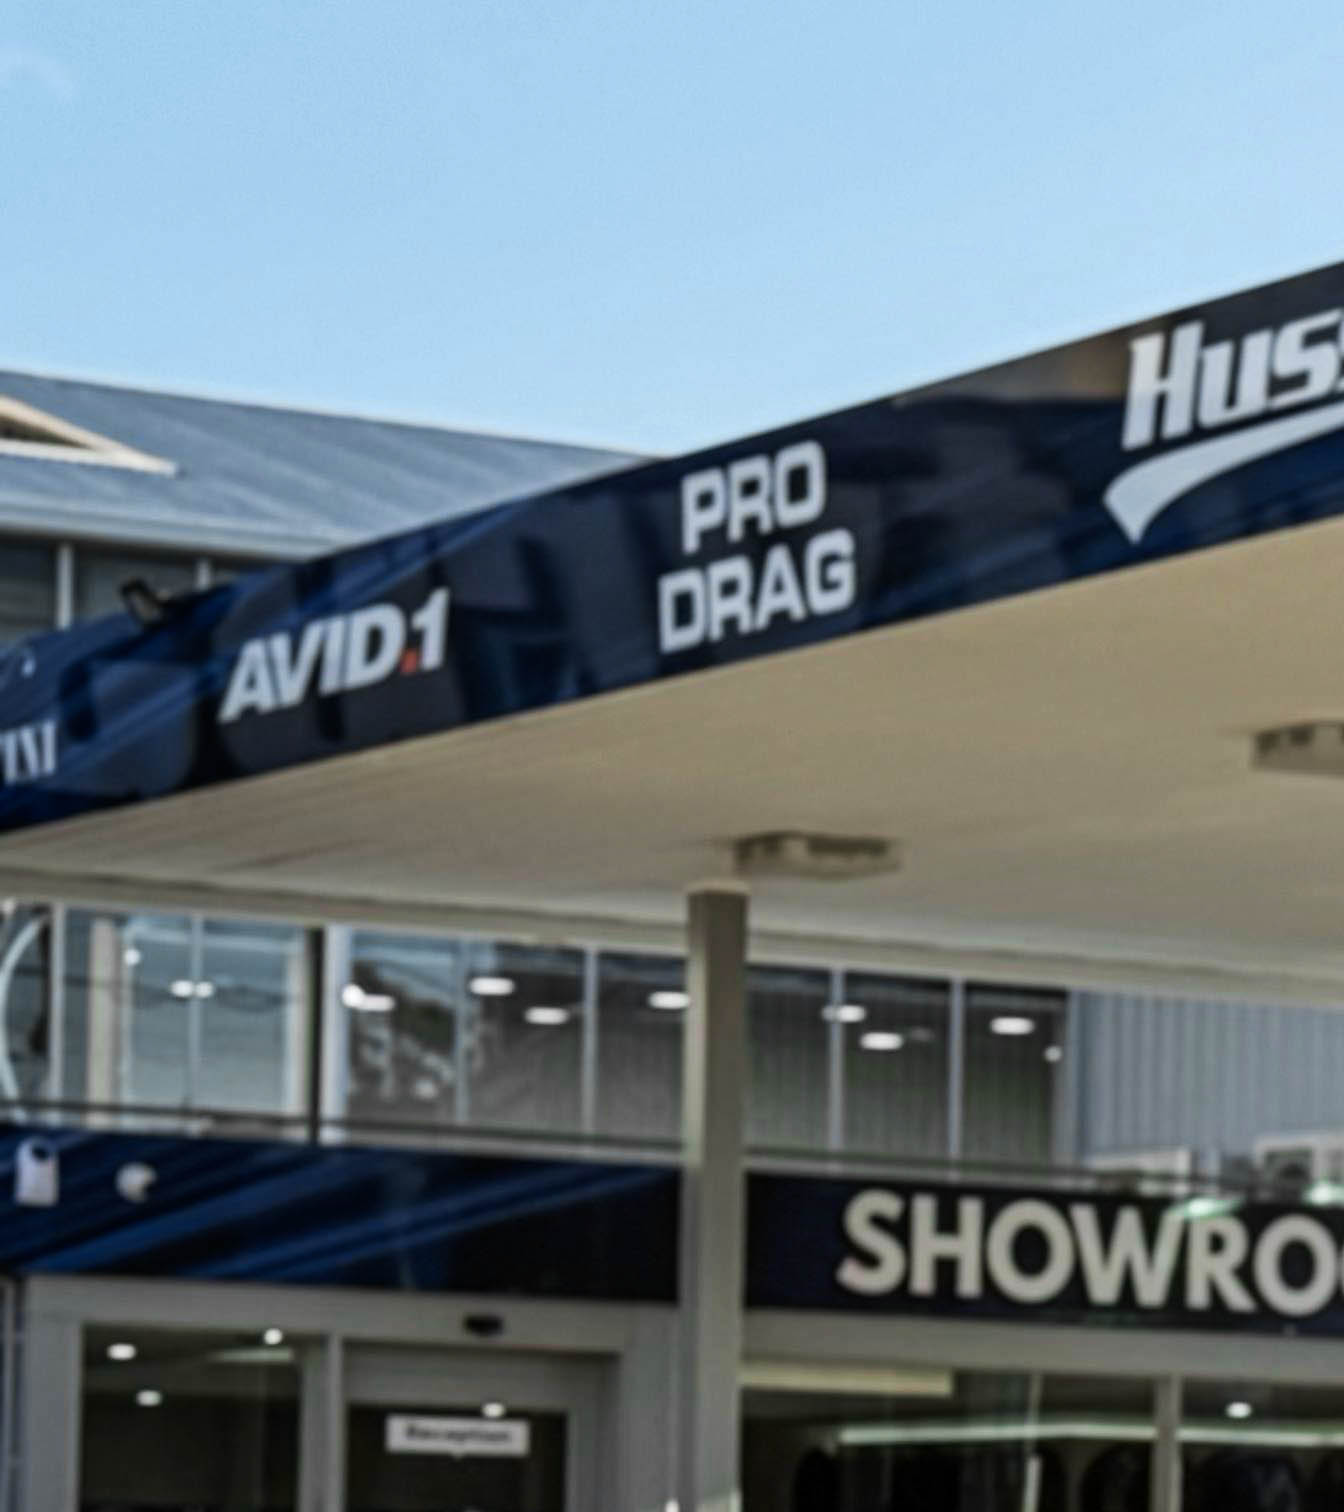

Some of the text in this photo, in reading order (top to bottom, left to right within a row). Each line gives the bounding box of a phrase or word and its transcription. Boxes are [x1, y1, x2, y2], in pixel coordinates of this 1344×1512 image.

[681, 441, 827, 554] PRO
[658, 529, 857, 653] DRAG
[219, 588, 450, 722] AVID.1
